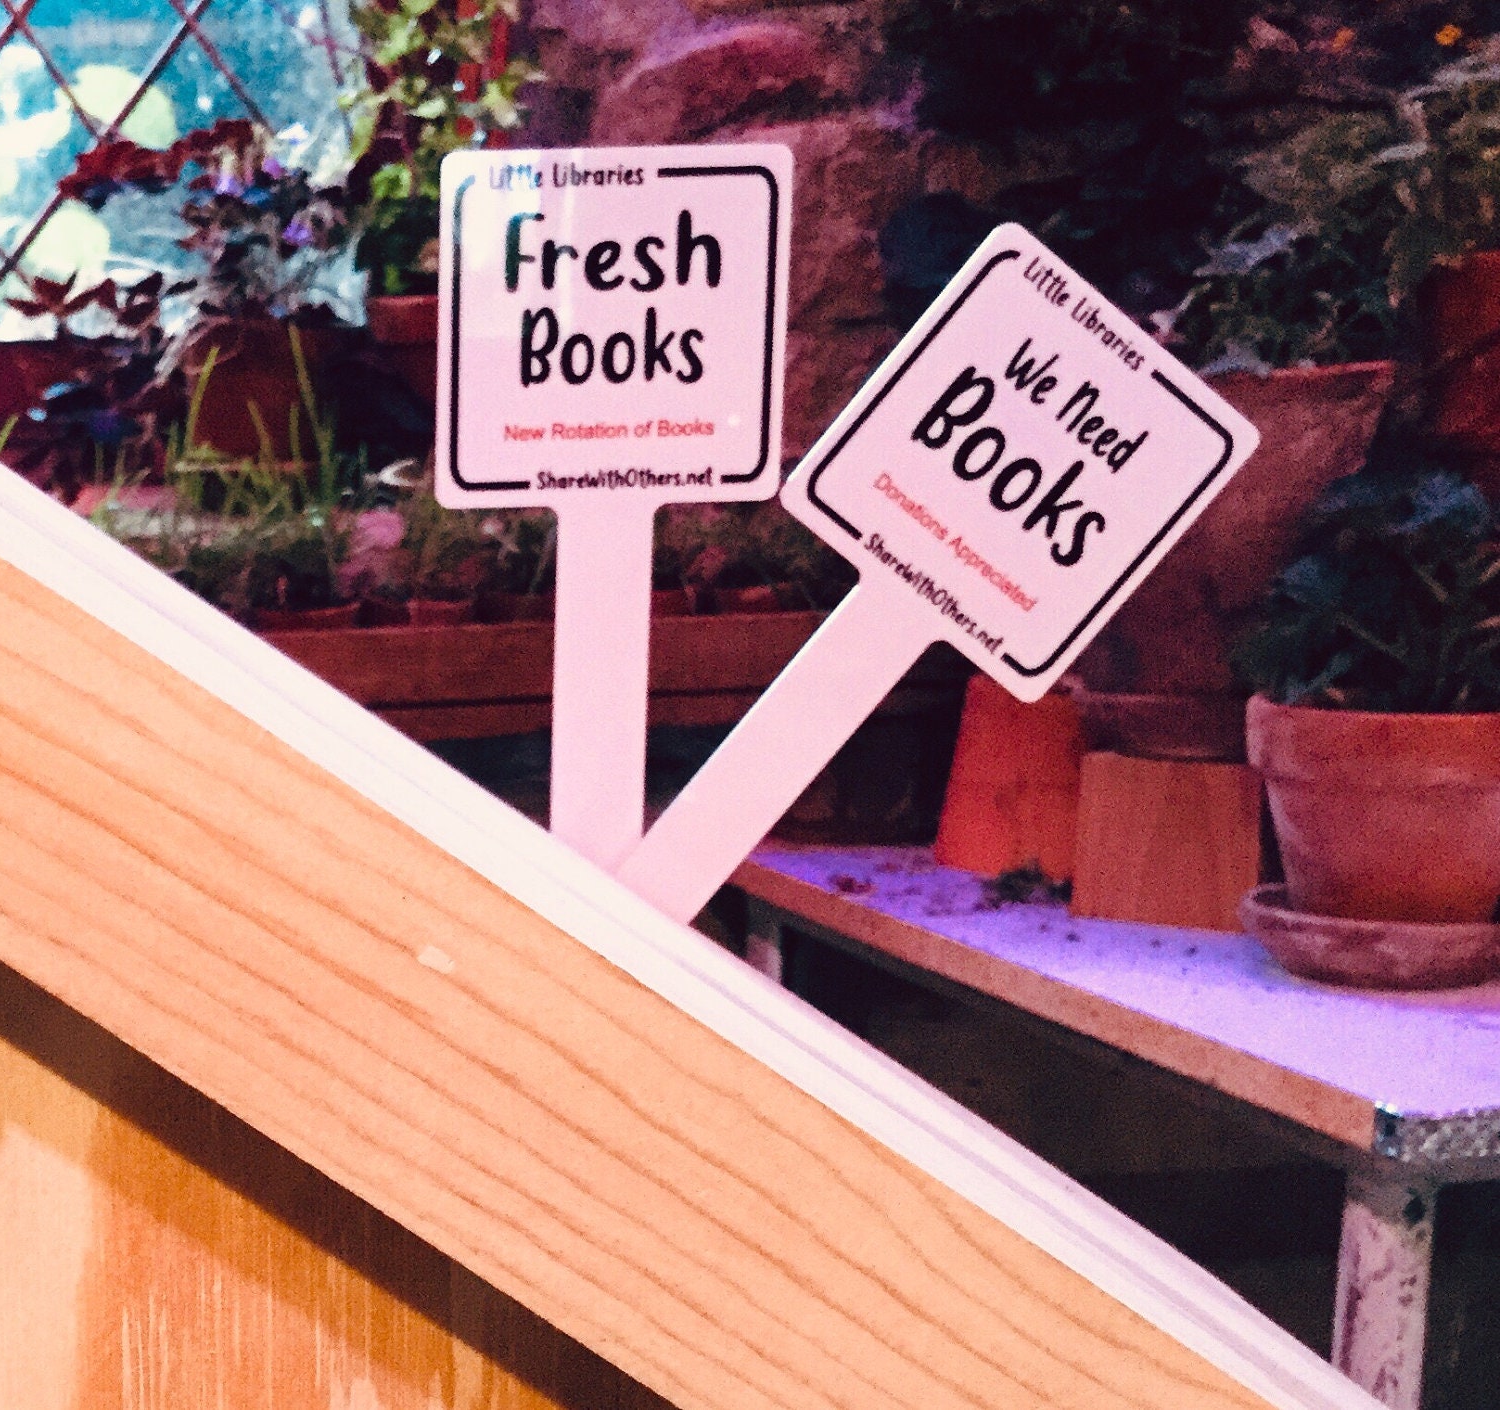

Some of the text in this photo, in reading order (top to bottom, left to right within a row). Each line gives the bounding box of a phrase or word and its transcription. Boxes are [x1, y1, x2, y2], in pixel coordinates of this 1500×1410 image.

[552, 163, 644, 188] Libraries
[505, 209, 722, 293] Fresh
[520, 306, 704, 388] Books
[1023, 257, 1145, 371] Little Libraries
[504, 418, 715, 442] New Rotation of Books
[1004, 338, 1149, 474] We Need
[911, 366, 1106, 567] Books
[873, 473, 1037, 612] Donations Appreciated
